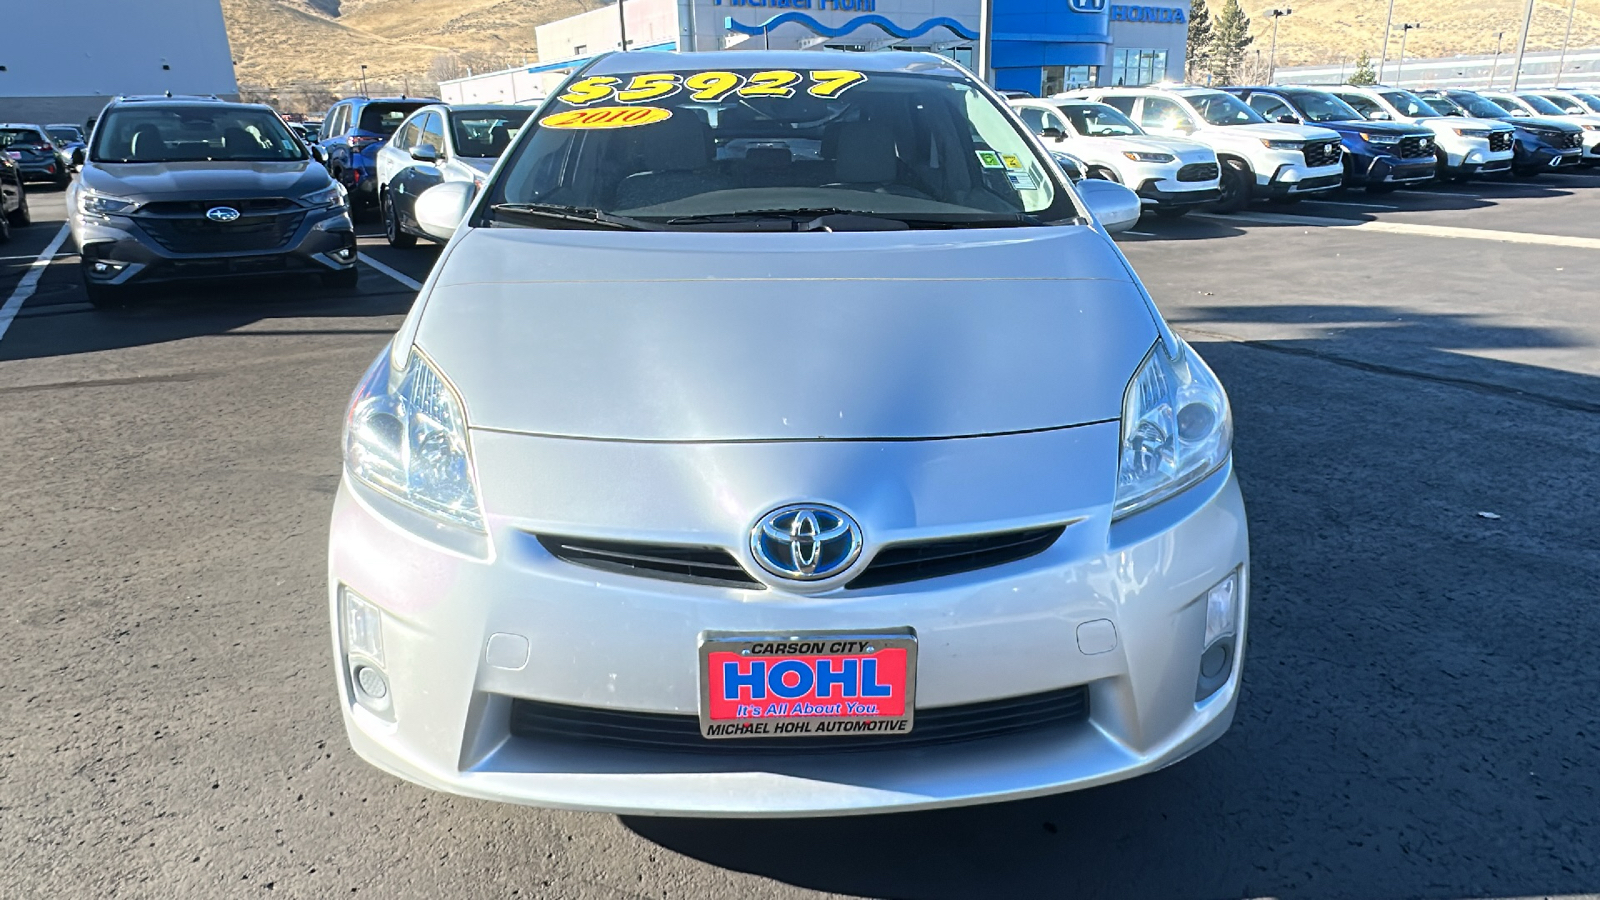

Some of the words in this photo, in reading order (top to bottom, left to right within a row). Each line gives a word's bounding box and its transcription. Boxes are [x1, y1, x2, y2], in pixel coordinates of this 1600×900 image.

[713, 0, 811, 9] cael
[1111, 5, 1187, 24] HONDA
[557, 70, 868, 106] $5927
[553, 108, 652, 126] 2010
[751, 642, 824, 655] CARSON
[828, 641, 869, 654] CITY
[723, 658, 892, 700] HOHL
[736, 704, 762, 717] It's
[765, 702, 788, 716] All
[792, 702, 842, 716] About
[706, 722, 770, 736] MICHAEL
[773, 721, 813, 734] HOHL
[815, 719, 908, 733] AUTOMOTIVE
